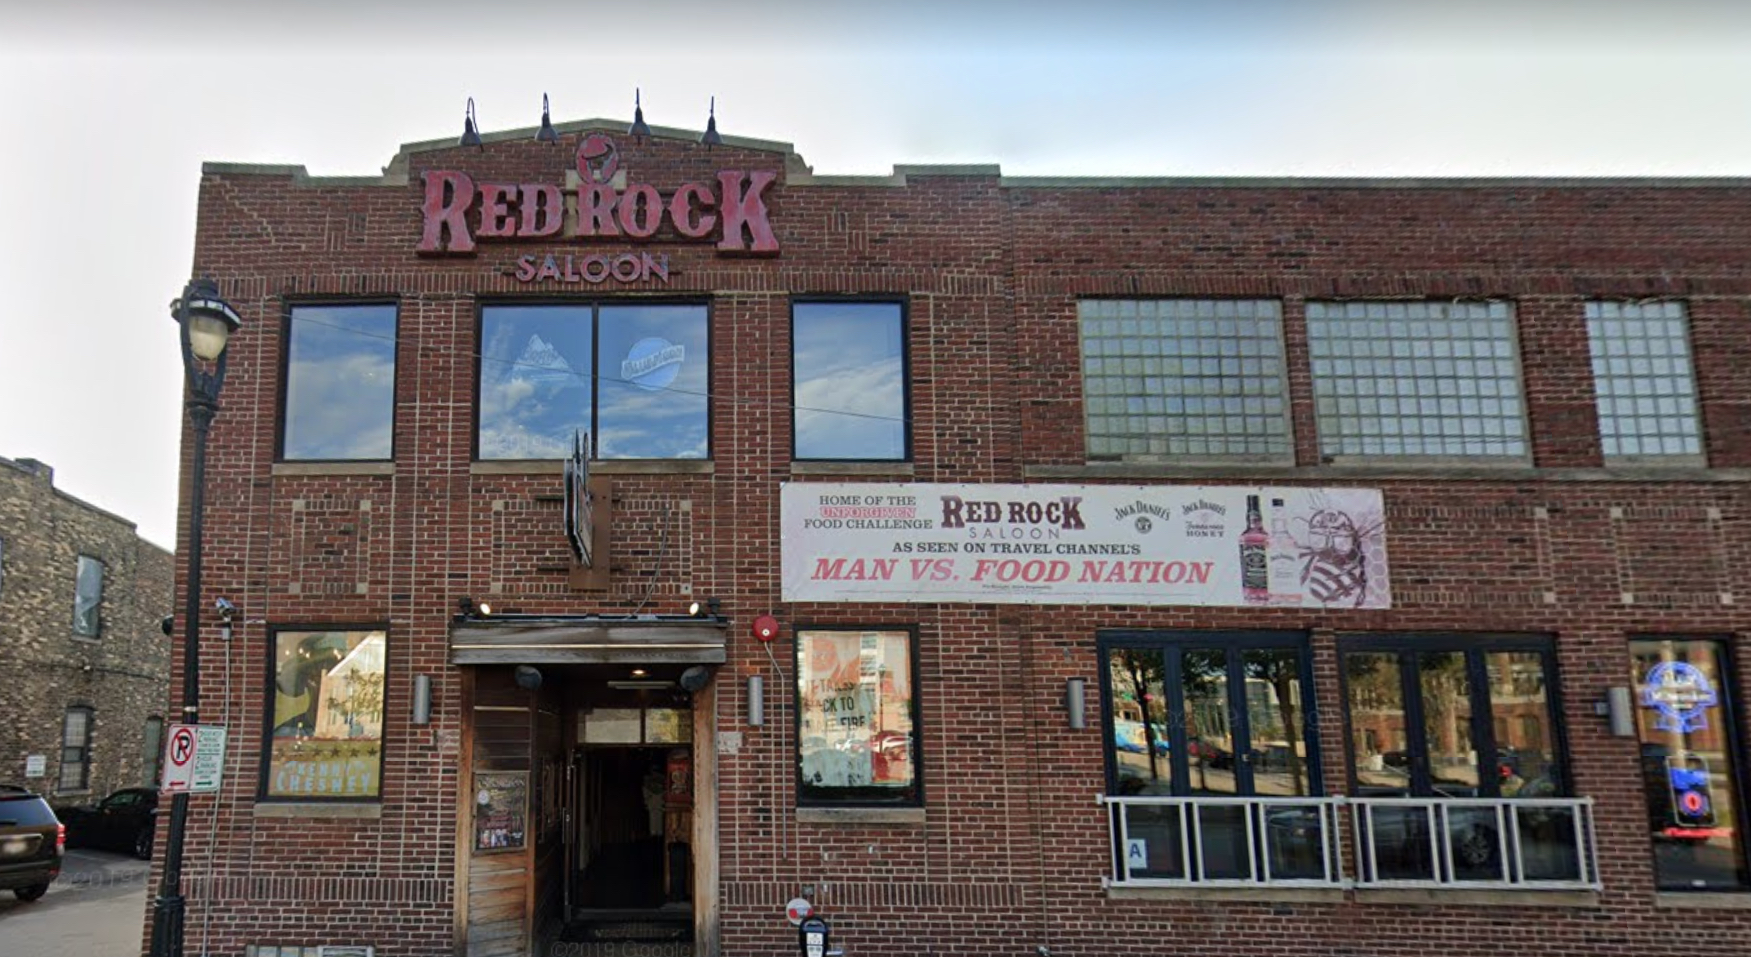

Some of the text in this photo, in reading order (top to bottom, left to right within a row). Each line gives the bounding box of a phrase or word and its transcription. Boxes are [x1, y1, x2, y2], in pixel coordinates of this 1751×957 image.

[416, 169, 780, 257] RED ROCK
[514, 251, 669, 283] SALOON
[819, 495, 916, 506] HOME OF THE
[941, 495, 1085, 530] RED ROCK
[804, 518, 933, 529] FOOD CHALLENGE
[969, 527, 1060, 539] SALOON
[1186, 530, 1225, 538] HONEY
[893, 542, 1141, 555] AS SEEN ON TRAVEL CHANNEL'S
[811, 558, 1214, 584] MAN VS. FOOD NATION
[1128, 842, 1144, 859] A
